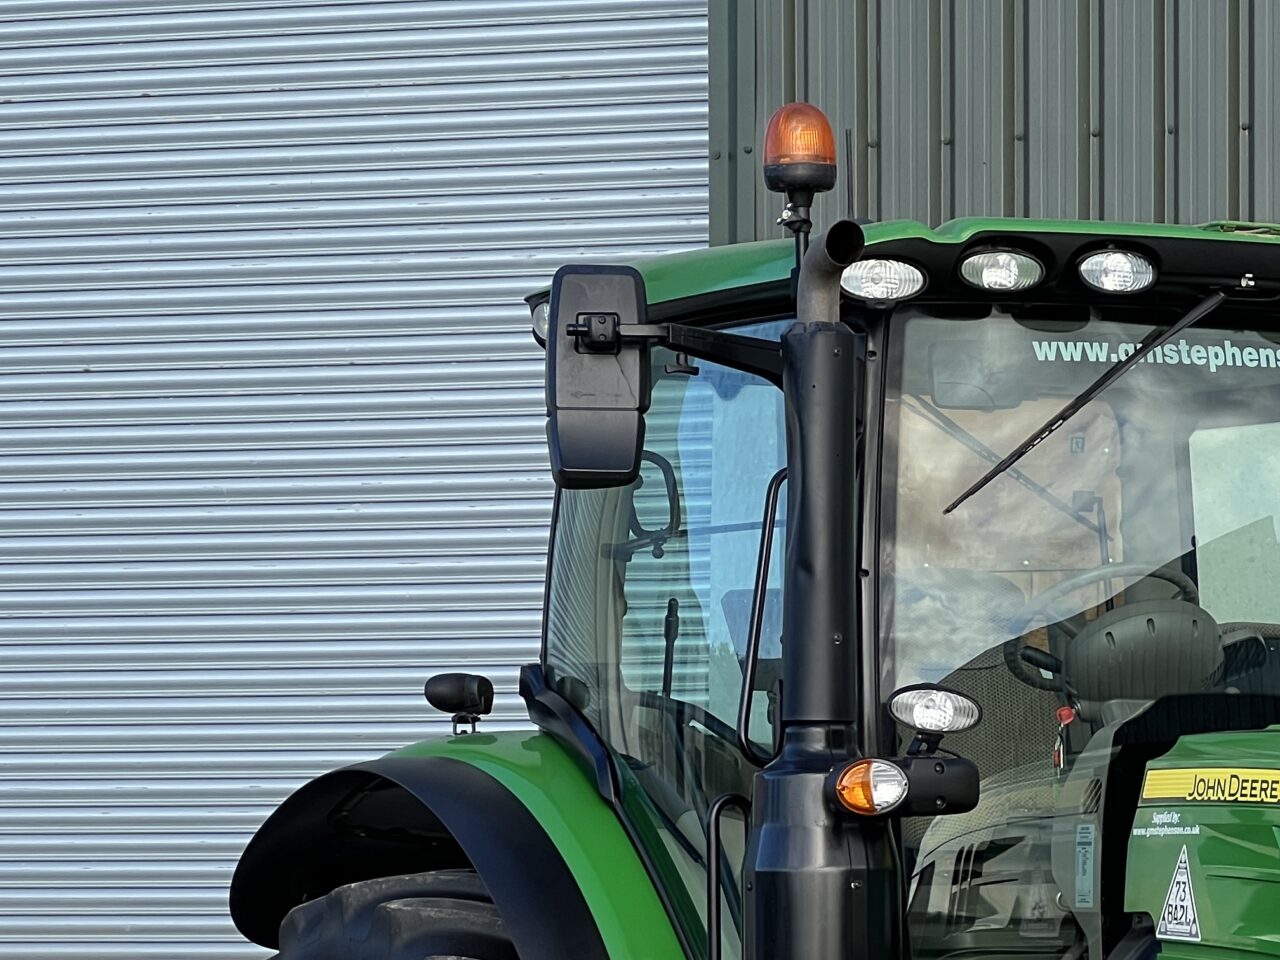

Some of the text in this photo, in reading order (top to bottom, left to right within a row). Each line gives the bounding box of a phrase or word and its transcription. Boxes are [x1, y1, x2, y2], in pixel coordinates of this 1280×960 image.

[1187, 773, 1280, 800] JOHN DEERE
[1175, 880, 1187, 902] 73
